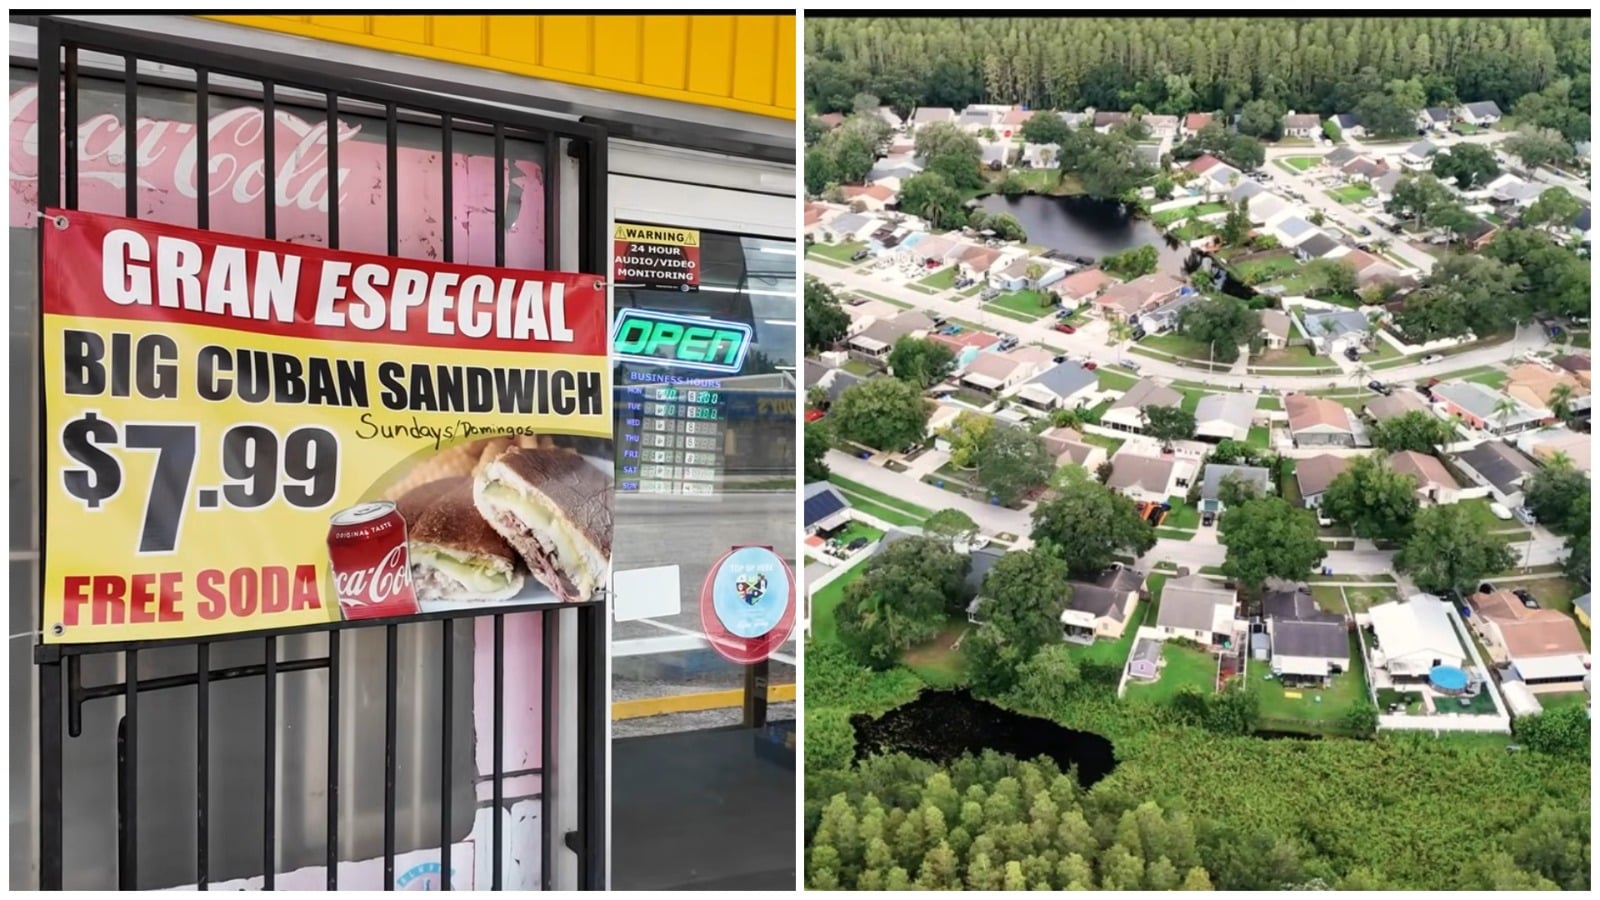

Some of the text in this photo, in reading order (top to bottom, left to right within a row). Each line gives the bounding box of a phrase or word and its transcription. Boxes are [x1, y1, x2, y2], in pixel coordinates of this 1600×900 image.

[626, 228, 684, 243] WARNING
[631, 244, 681, 256] 24 HOUR
[614, 256, 696, 269] AUDIO/VIDEO
[617, 268, 694, 281] MONITORING
[102, 228, 574, 343] GRAN ESPECIAL
[614, 318, 742, 365] OPEN
[63, 329, 603, 416] BIG CUBAN SANDWICH
[630, 371, 721, 389] BUSINESS HOURS
[627, 402, 641, 411] TUE
[624, 434, 639, 443] THU
[624, 450, 638, 459] FRI
[623, 466, 637, 474] SAT
[62, 411, 339, 553] $7.99
[335, 520, 393, 540] ORIGINAL TASTE
[63, 564, 322, 626] FREE SODA
